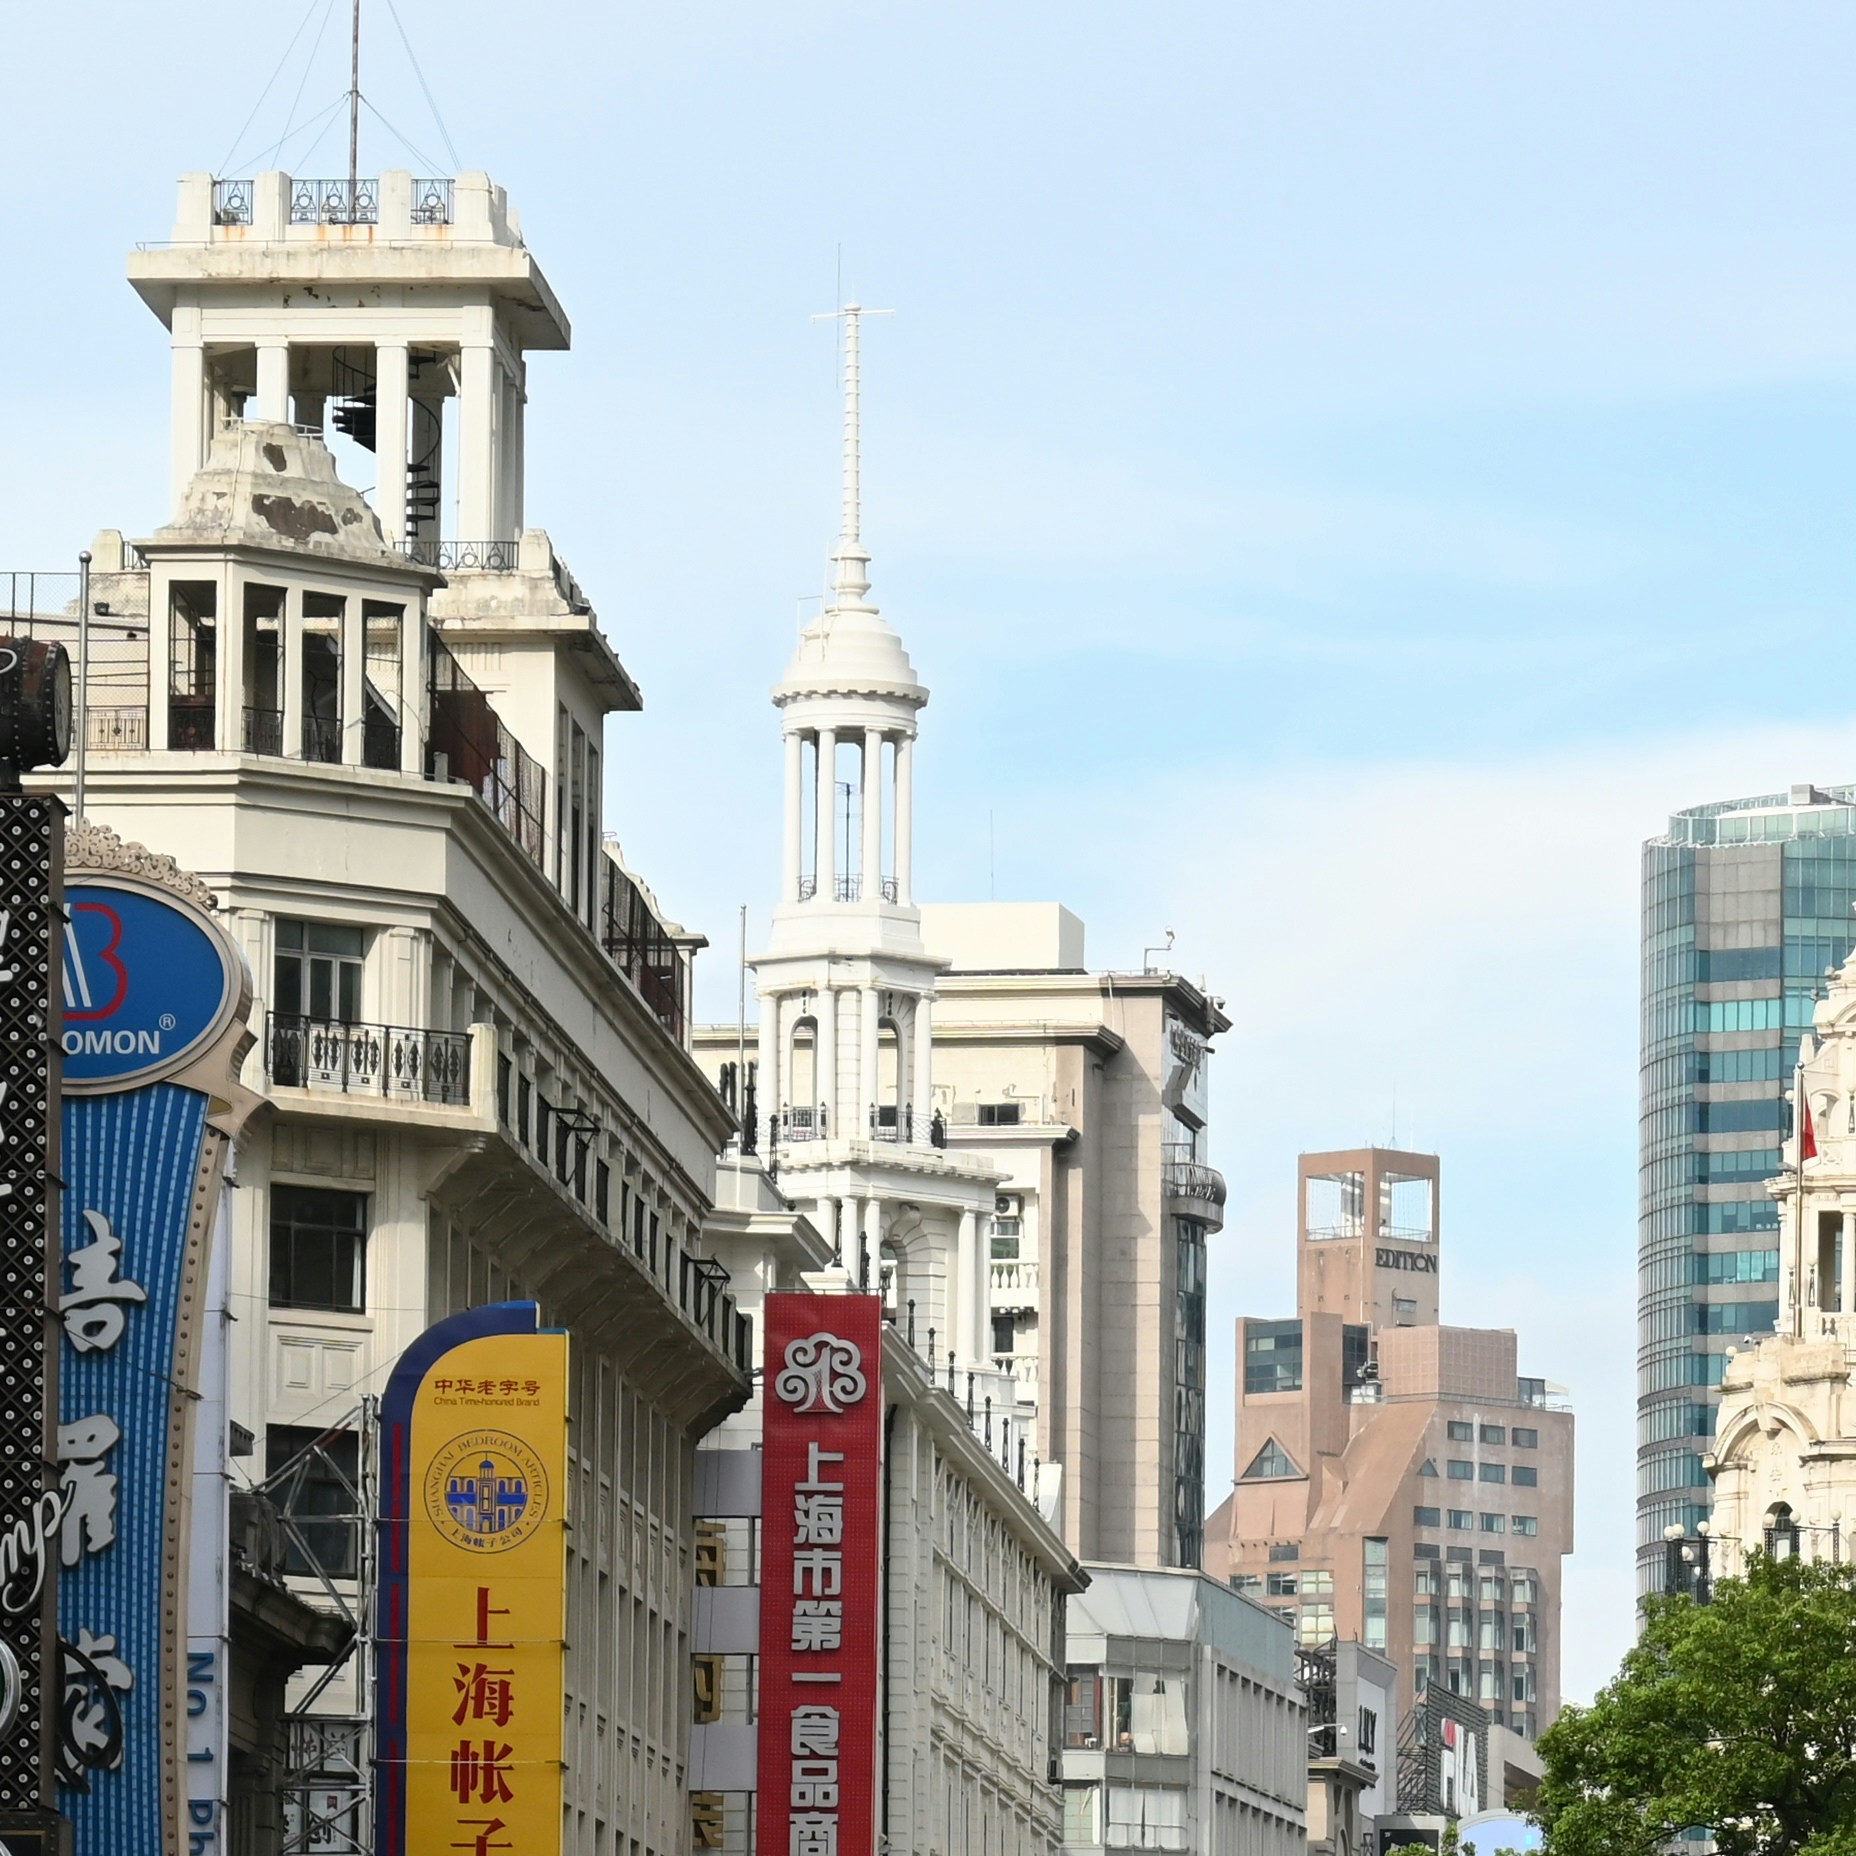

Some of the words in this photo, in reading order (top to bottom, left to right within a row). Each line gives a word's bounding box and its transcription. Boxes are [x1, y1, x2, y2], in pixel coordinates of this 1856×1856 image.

[434, 1379, 541, 1396] 中华老字号
[434, 1397, 458, 1406] China
[457, 1435, 523, 1459] BEDROOM
